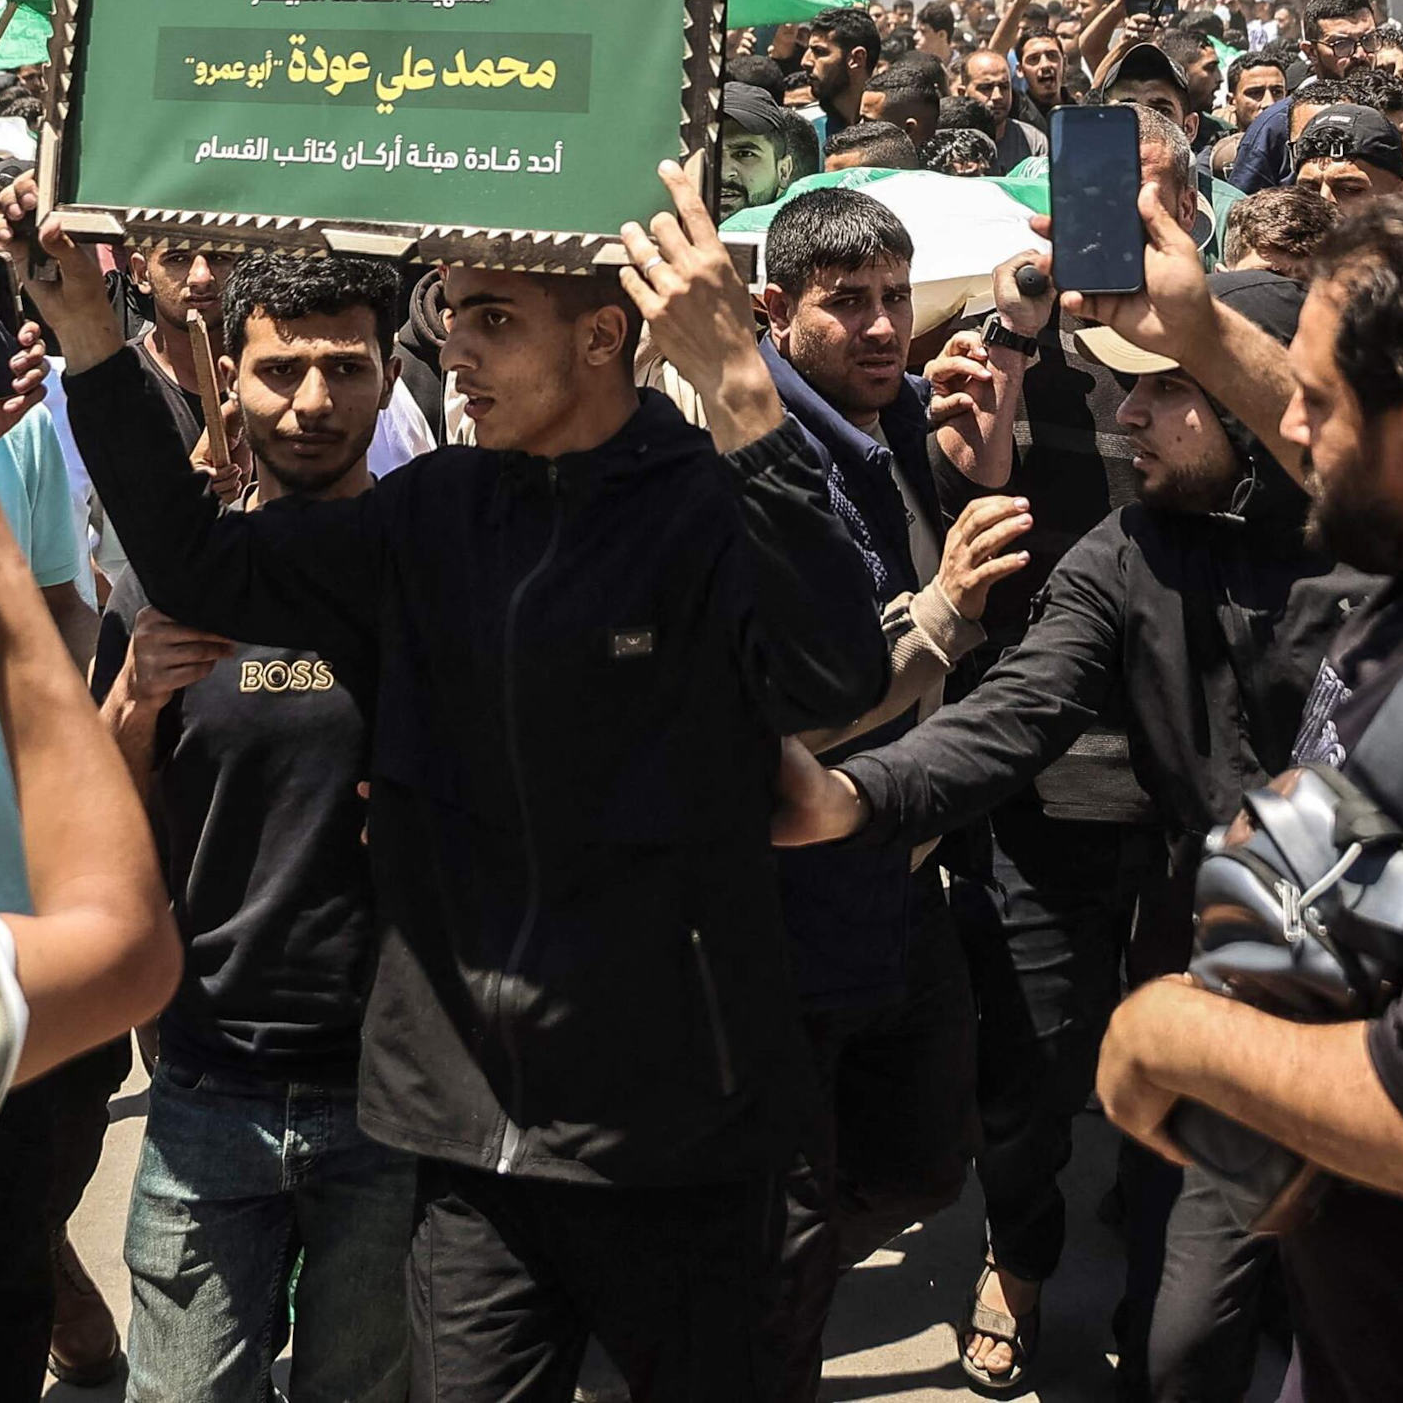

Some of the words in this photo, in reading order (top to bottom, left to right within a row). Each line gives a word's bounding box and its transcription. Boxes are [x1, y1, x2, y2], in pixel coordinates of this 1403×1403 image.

[289, 35, 370, 95] عودة
[377, 47, 435, 113] علي
[443, 50, 555, 88] محمد
[195, 136, 268, 163] القسام
[274, 139, 336, 166] كتائب
[342, 135, 402, 171] أركان
[406, 143, 458, 173] هيئة
[465, 147, 520, 170] قادة
[527, 141, 562, 172] أحد
[240, 660, 334, 693] BOSS
